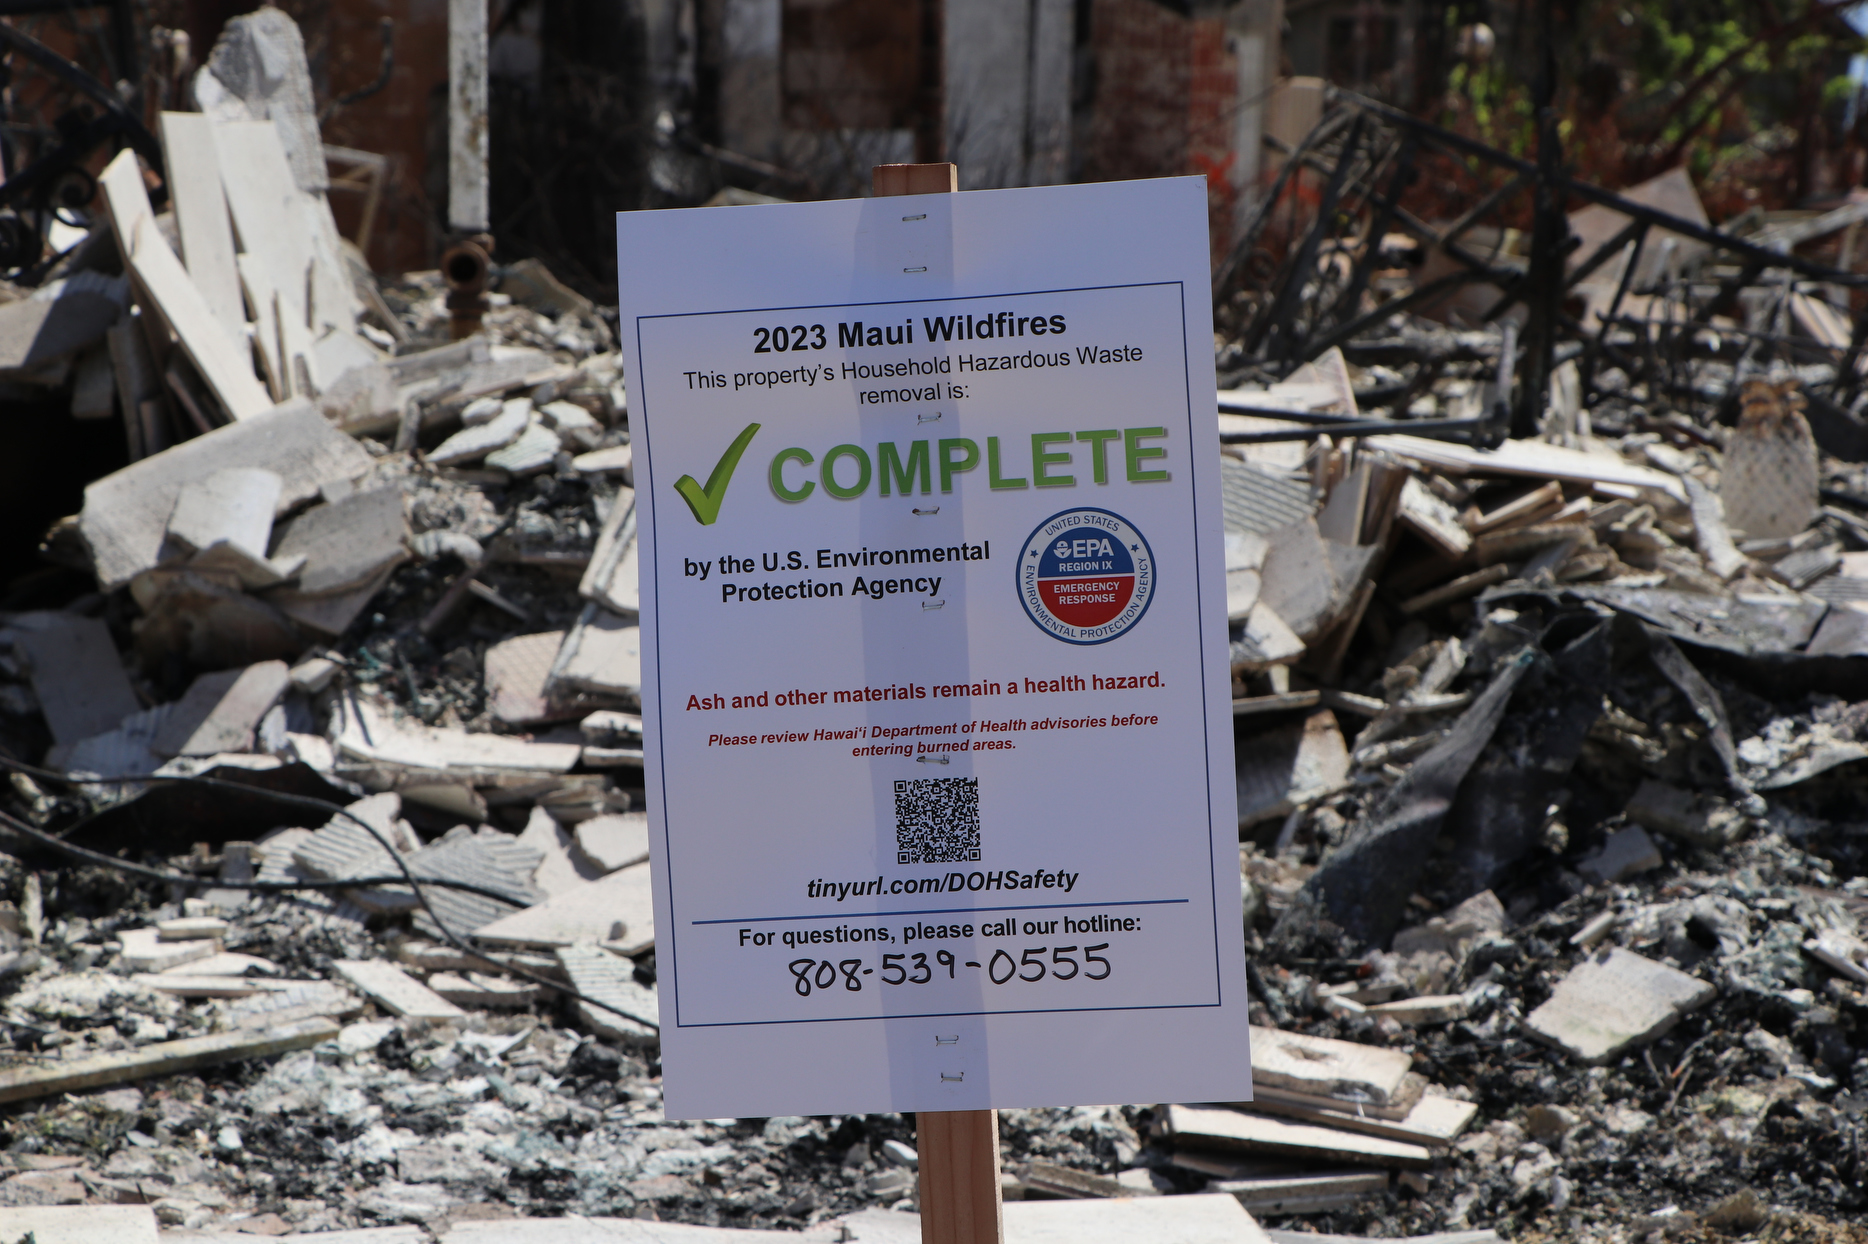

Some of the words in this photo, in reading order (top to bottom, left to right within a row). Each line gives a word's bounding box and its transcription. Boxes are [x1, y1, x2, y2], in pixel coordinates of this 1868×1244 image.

[754, 324, 826, 353] 2023
[838, 318, 913, 348] Maui
[923, 312, 1066, 342] Wildfires
[683, 371, 727, 389] This
[842, 356, 951, 379] Household
[959, 350, 1070, 372] Hazardous
[1076, 345, 1142, 364] Waste
[860, 383, 941, 404] removal
[947, 382, 969, 399] is:
[769, 427, 1171, 503] COMPLETE
[1045, 516, 1080, 536] UNITED
[1084, 515, 1120, 531] STATES
[685, 558, 712, 581] by
[719, 555, 755, 574] the
[763, 551, 808, 571] U.S.
[817, 540, 989, 568] Environmental
[1073, 539, 1114, 558] EPA
[1059, 561, 1099, 572] REGION
[1102, 561, 1112, 569] IX
[722, 579, 843, 602] Protection
[851, 576, 942, 599] Agency
[1026, 565, 1076, 637] ENVIRONMENTAL
[1080, 603, 1139, 638] PROTECTION
[1136, 558, 1148, 601] AGENCY
[1054, 582, 1120, 593] EMERGENCY
[1059, 594, 1115, 604] RESPONSE
[686, 694, 725, 711] Ash
[732, 691, 768, 708] and
[775, 689, 828, 706] other
[834, 683, 926, 703] materials
[933, 679, 1000, 698] remain
[1007, 682, 1018, 694] a
[1025, 675, 1085, 693] health
[1092, 671, 1165, 690] hazard.
[709, 734, 757, 746] Please
[760, 729, 809, 744] review
[871, 723, 957, 740] Department
[961, 721, 977, 733] of
[980, 719, 1026, 732] Health
[1031, 716, 1107, 730] advisories
[1111, 714, 1158, 726] before
[852, 742, 913, 757] entering
[917, 739, 968, 754] burned
[972, 737, 1016, 752] areas.
[808, 869, 1079, 902] tinyurl.com/DOHSafety
[739, 929, 775, 946] For
[782, 925, 895, 949] questions,
[904, 922, 974, 944] please
[981, 918, 1016, 937] call
[1023, 921, 1058, 935] our
[1064, 914, 1141, 933] hotline:
[789, 943, 1111, 996] 808-539-0555
